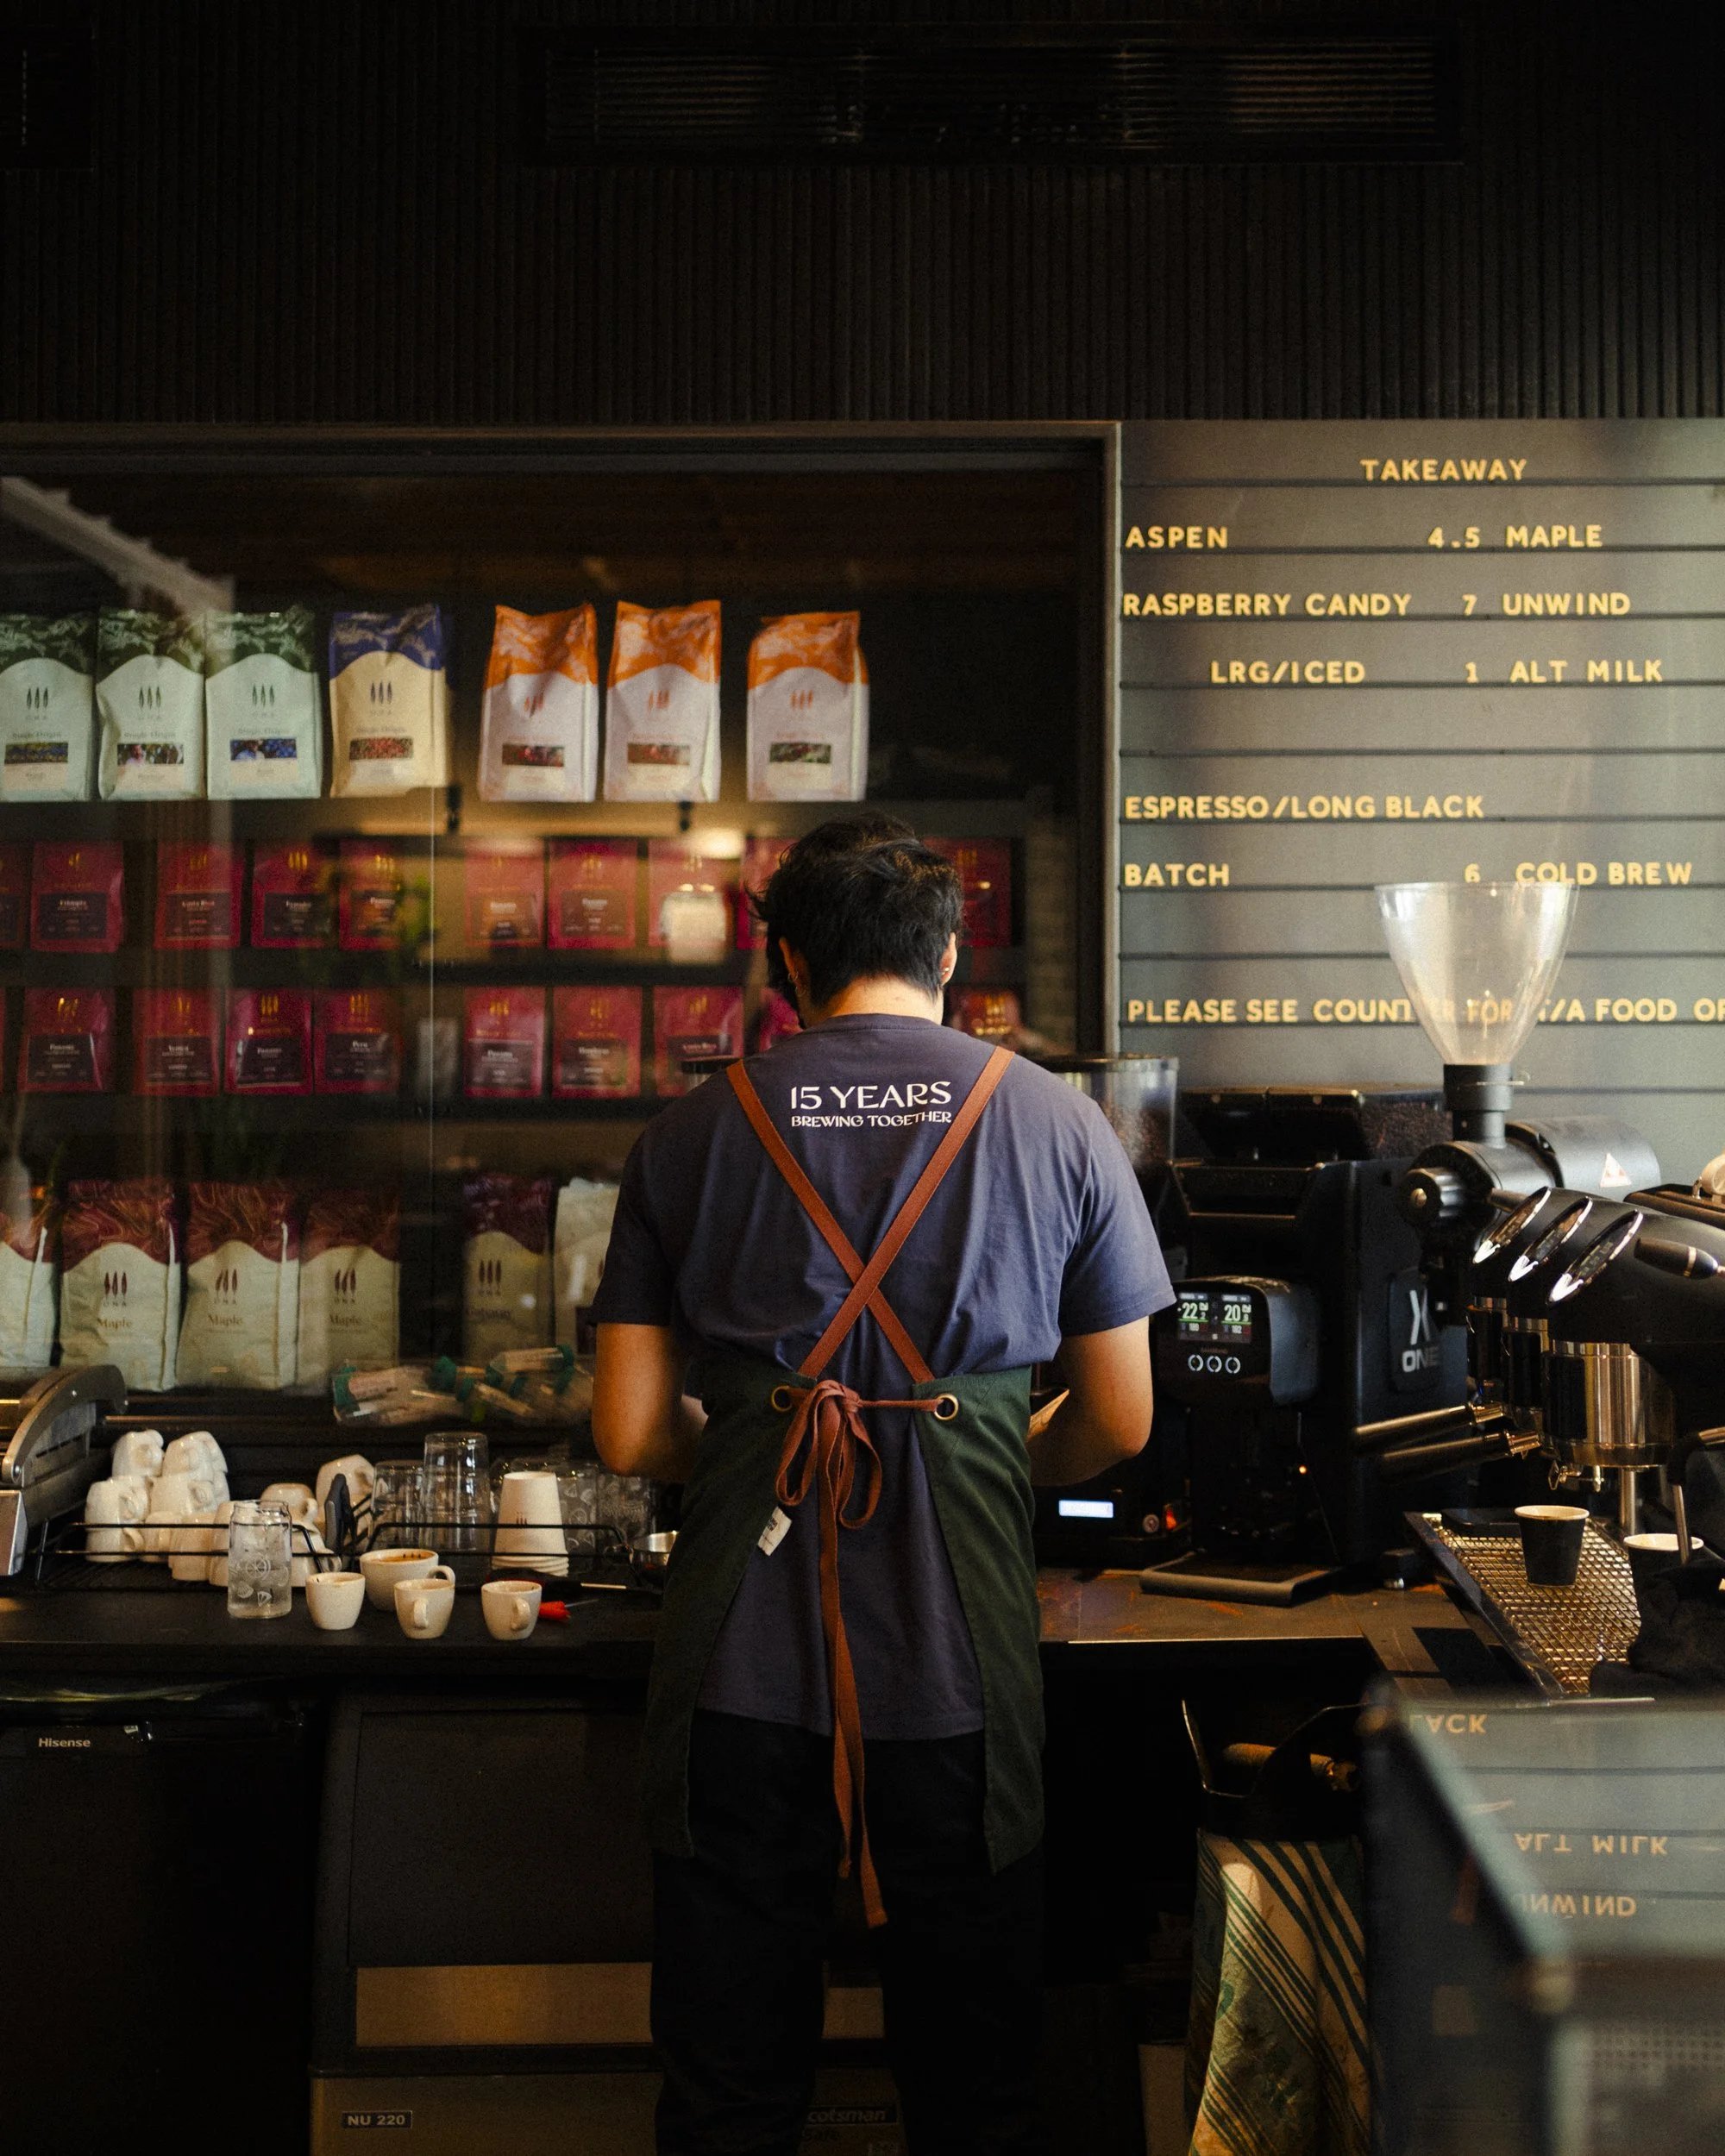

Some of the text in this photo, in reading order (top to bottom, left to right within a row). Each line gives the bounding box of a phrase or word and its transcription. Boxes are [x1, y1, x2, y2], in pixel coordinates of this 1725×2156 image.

[1360, 458, 1527, 482] TAKEAWAY
[1125, 525, 1482, 549] ASPEN 4.5
[1505, 523, 1603, 548] MAPLE
[1122, 592, 1477, 617] RASPBERRY CANDY 7
[1502, 592, 1631, 617] UNWIND
[1210, 660, 1479, 684] LRG/ICED 1
[1509, 659, 1663, 684] ALT MILK
[1125, 795, 1484, 819] ESPRESSO/LONG BLACK
[1124, 862, 1482, 887] BATCH 6
[1515, 862, 1692, 886] COLD BREW
[1128, 999, 1238, 1024] PLEASE
[1245, 999, 1298, 1023] SEE
[1312, 998, 1455, 1023] COUNT
[1595, 998, 1678, 1023] FOOD
[791, 1081, 952, 1109] 15 YEARS
[791, 1111, 952, 1127] BREWING TOGETHER
[38, 1738, 91, 1747] Hisense
[347, 2115, 405, 2126] NU 220
[806, 2109, 887, 2122] cotsman
